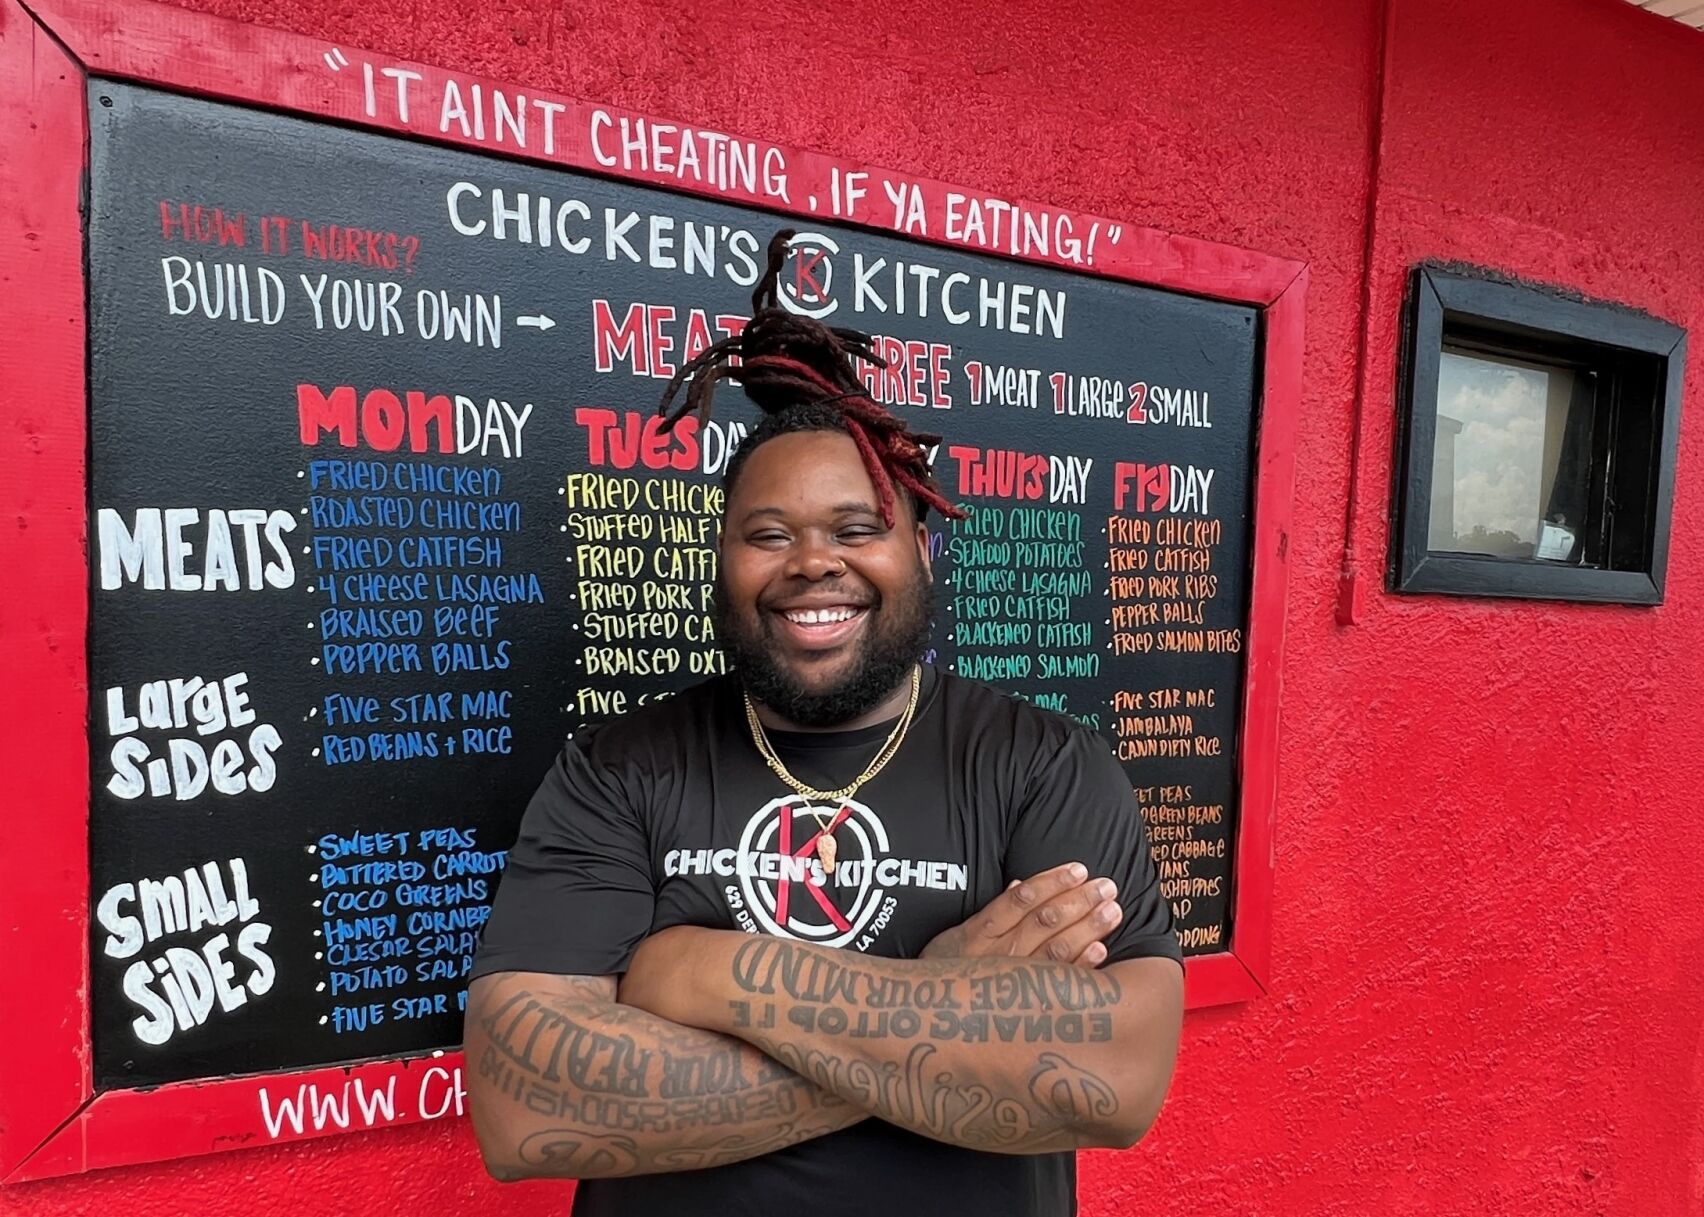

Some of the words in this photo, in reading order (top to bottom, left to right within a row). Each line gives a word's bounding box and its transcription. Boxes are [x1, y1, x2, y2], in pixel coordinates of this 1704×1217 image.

[439, 79, 565, 155] AINT
[831, 167, 869, 217] IF
[883, 179, 927, 236] YA
[158, 200, 246, 249] HOW
[259, 214, 292, 256] IT
[302, 220, 420, 276] WORKS?
[446, 181, 759, 289] CHICKEN'S
[852, 252, 1067, 339] KITCHEN
[161, 255, 287, 326] BUILD
[299, 272, 405, 337] YOUR
[416, 288, 502, 349] OWN
[849, 333, 952, 409] HREE
[645, 478, 726, 516] CHICKe
[659, 513, 711, 544] HALF
[97, 507, 298, 593] MEATS
[398, 537, 503, 570] CATFISH
[950, 537, 1011, 568] SEAFOOD
[1154, 547, 1210, 573] CATFISH
[317, 574, 337, 605] 4
[436, 573, 545, 605] LASAGNA
[642, 580, 696, 611] PORK
[952, 569, 963, 594] 4
[1022, 570, 1092, 598] LASAGNA
[1148, 575, 1181, 600] PORK
[1184, 574, 1218, 600] RIBS
[1004, 594, 1071, 621] CATFISH
[1111, 602, 1160, 632] PEPPER
[1162, 600, 1206, 625] BALLS
[1037, 621, 1092, 649] CATFISH
[1156, 629, 1204, 653] SALMON
[431, 640, 513, 676] BALLS
[390, 692, 453, 726] STAR
[460, 690, 513, 719] MAC
[1149, 688, 1182, 710] STAR
[1186, 688, 1217, 708] MAC
[322, 734, 366, 766] RED
[370, 731, 439, 761] BEANS
[1159, 785, 1193, 804] PEAS
[1187, 803, 1224, 825] BEANS
[318, 829, 411, 860] SWEET
[417, 826, 478, 852] PEAS
[319, 859, 427, 889] BUTTERED
[663, 847, 828, 888] CHICKEN'S
[834, 857, 969, 892] KITCHEN
[321, 888, 389, 917] COCO
[395, 877, 488, 907] GREENS
[724, 884, 743, 910] 629
[322, 912, 397, 947] HONEY
[855, 934, 875, 953] LA
[868, 896, 899, 937] 70053
[416, 931, 480, 959] SALA
[330, 964, 409, 997] POTATO
[415, 954, 473, 983] SALA
[731, 936, 859, 1007] MIND
[863, 972, 962, 1010] YOUR
[331, 1003, 386, 1034] FIVE
[391, 993, 448, 1021] STAR
